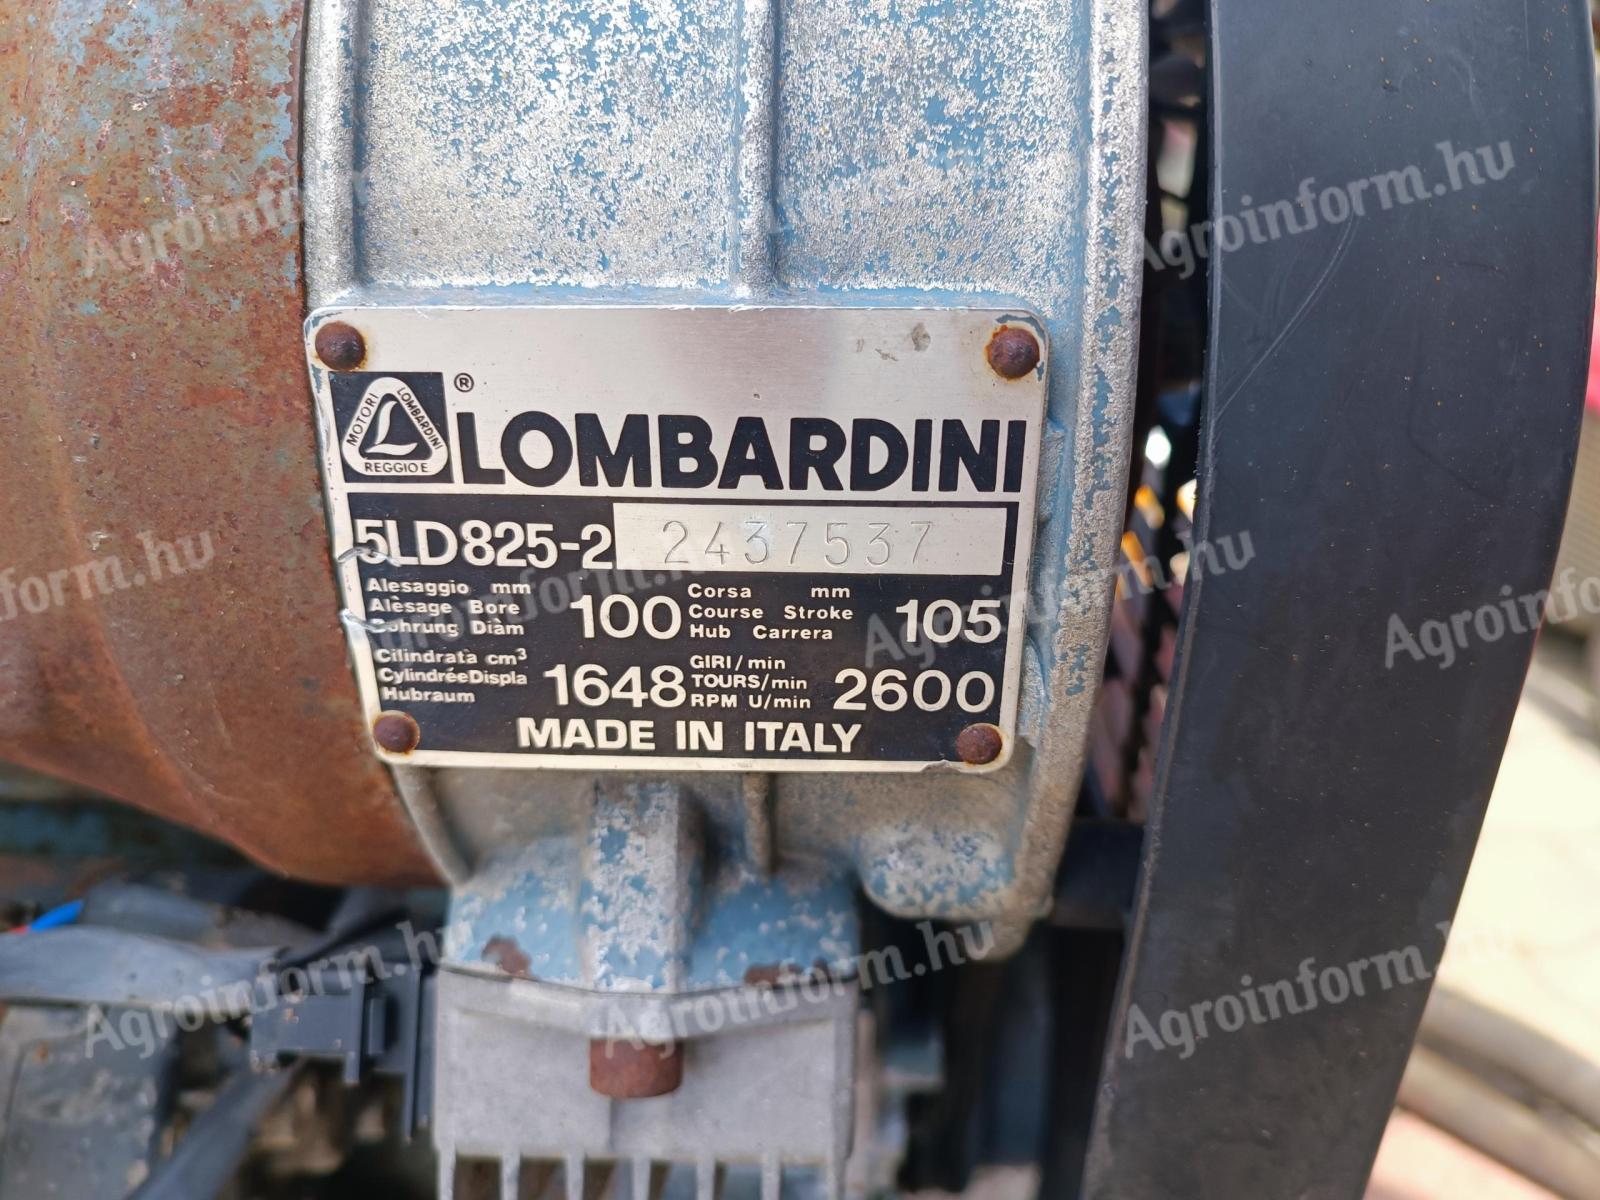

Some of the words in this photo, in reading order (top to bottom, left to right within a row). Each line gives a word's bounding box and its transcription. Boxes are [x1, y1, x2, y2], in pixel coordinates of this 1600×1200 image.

[346, 392, 379, 447] MOTORI
[396, 386, 443, 450] LOMBARDINI
[456, 410, 1027, 492] LOMBARDINI
[662, 520, 931, 567] 2437537
[367, 578, 470, 596] Alesaggio
[491, 582, 531, 594] mm
[687, 583, 752, 599] Corsa
[811, 585, 850, 598] mm
[469, 599, 520, 615] Bore
[570, 593, 682, 640] 100
[688, 604, 764, 619] Course
[784, 605, 853, 620] Stroke
[896, 599, 1001, 644] 105
[690, 624, 731, 639] Hub
[752, 624, 833, 640] Carrera
[381, 687, 476, 703] Hubraum
[543, 662, 687, 709] 1648
[691, 673, 807, 691] TOURS/min
[833, 668, 996, 713] 2600
[691, 693, 738, 708] RPM
[748, 693, 811, 710] U/min
[517, 717, 656, 750] MADE
[675, 720, 723, 751] IN
[745, 721, 862, 753] ITALY
